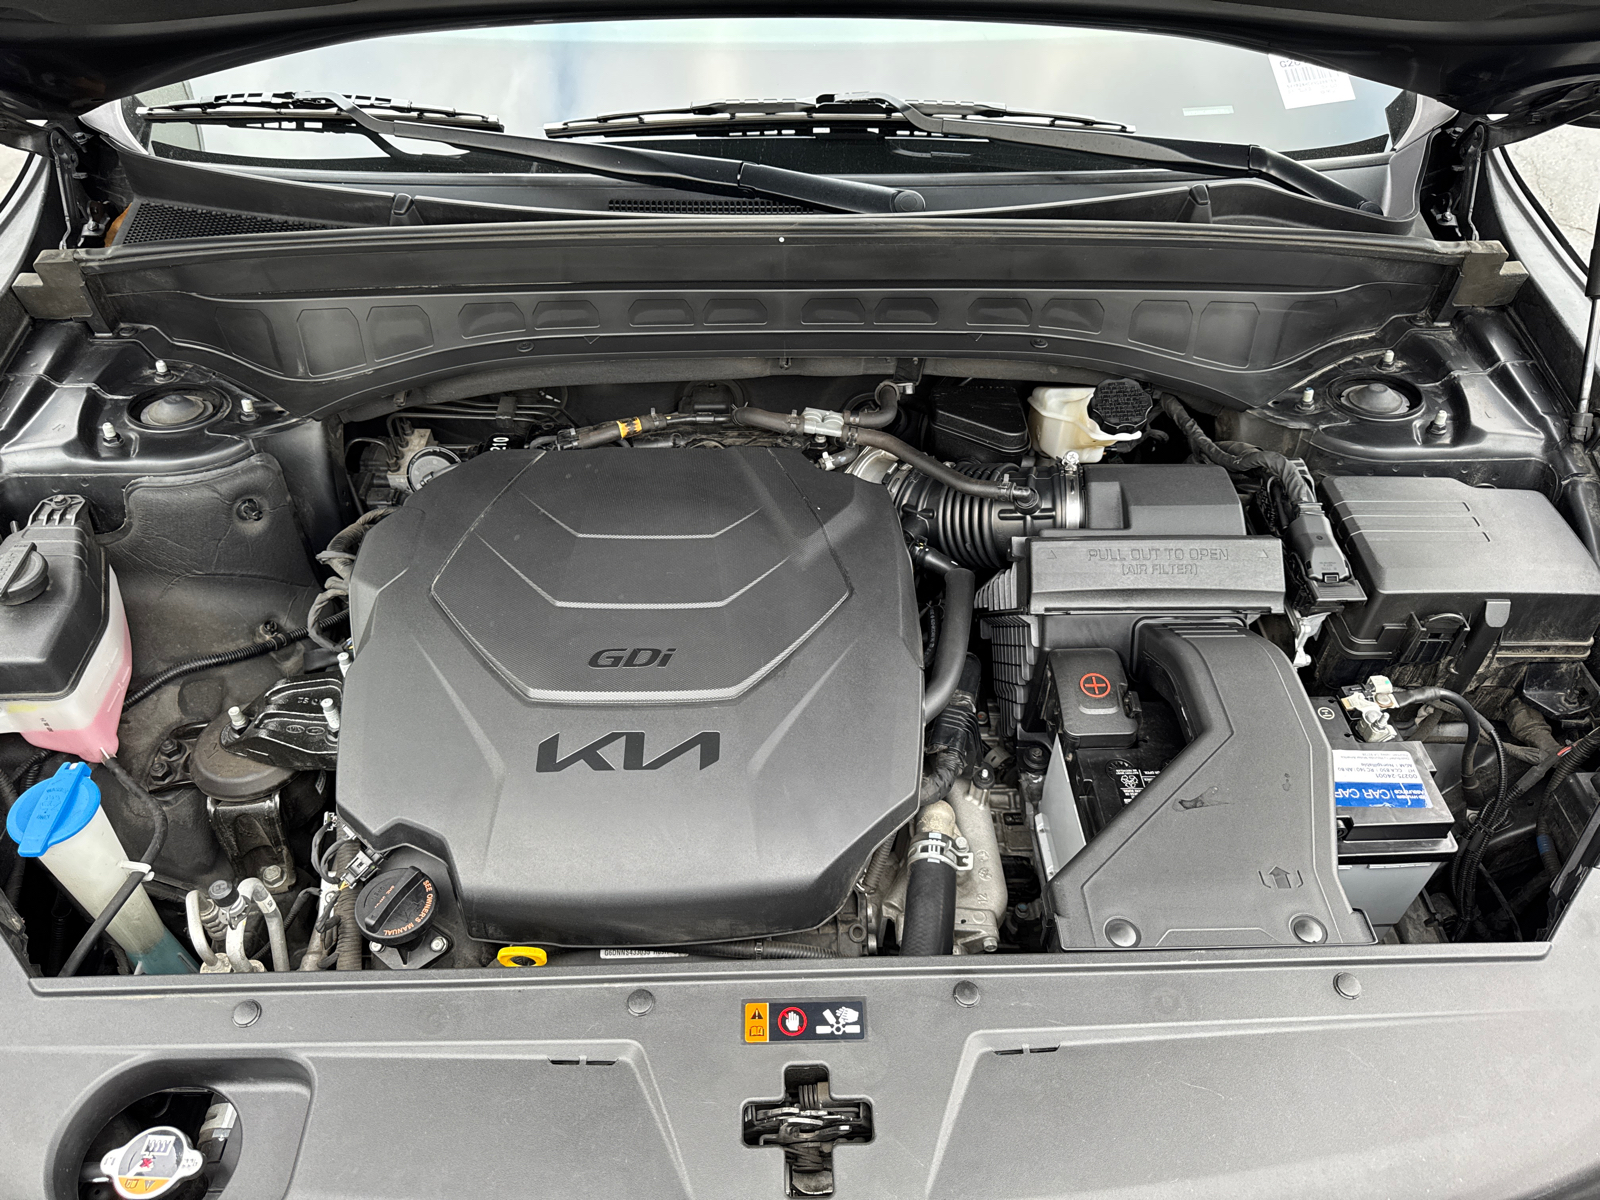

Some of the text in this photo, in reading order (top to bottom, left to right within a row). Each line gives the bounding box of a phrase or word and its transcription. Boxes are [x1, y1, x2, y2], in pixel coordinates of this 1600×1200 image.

[1087, 548, 1229, 561] PULL OUT TO OPEN
[1121, 563, 1197, 576] (AIR FILTER)
[588, 648, 677, 669] GDi
[536, 731, 721, 773] KIA
[1362, 788, 1390, 799] CAR
[423, 880, 433, 893] SEE
[414, 893, 434, 923] OWNER'S
[383, 922, 415, 936] MANUAL
